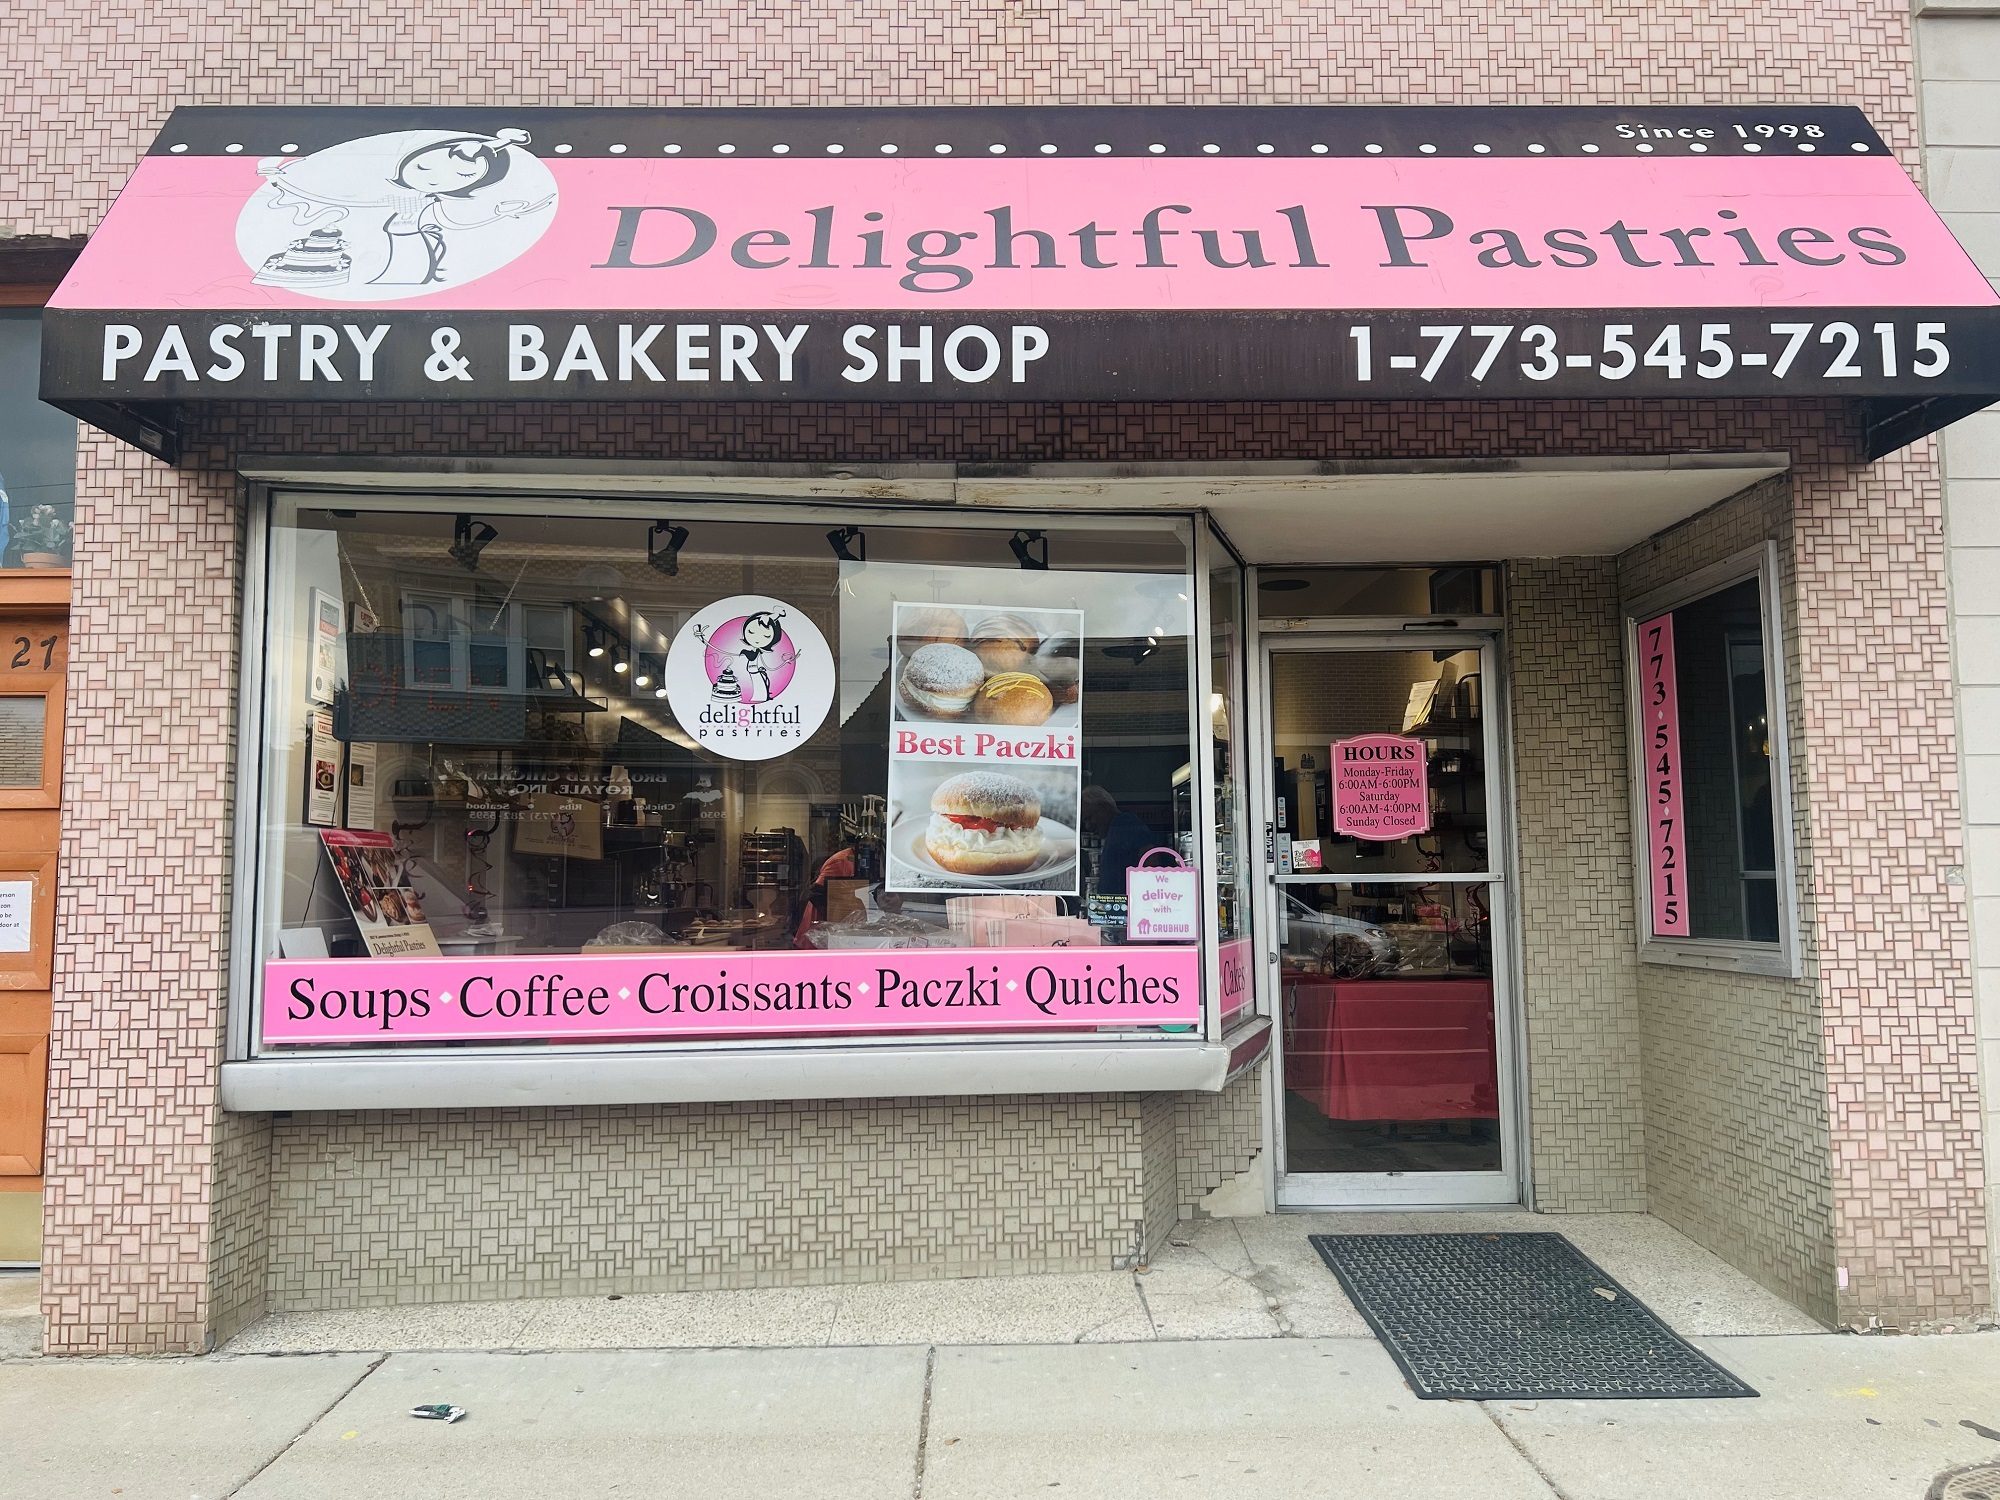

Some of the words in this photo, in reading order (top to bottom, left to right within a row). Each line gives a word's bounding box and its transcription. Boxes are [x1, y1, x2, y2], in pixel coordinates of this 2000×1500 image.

[1615, 124, 1715, 139] Since
[1732, 124, 1825, 138] 1998
[590, 204, 1331, 293] Delightful
[1360, 205, 1907, 269] Pastries
[102, 324, 392, 382] PASTRY
[423, 326, 474, 382] &
[508, 324, 810, 382] BAKERY
[841, 324, 1050, 383] SHOP
[1349, 322, 1950, 383] 1-773-545-7215
[700, 704, 800, 727] delightful
[700, 728, 801, 739] pastries
[896, 730, 966, 756] Best
[974, 733, 1076, 760] Paczki
[1344, 745, 1415, 760] HOURS
[1343, 766, 1414, 779] Monday-Friday
[1359, 791, 1400, 803] Saturday
[1346, 816, 1380, 828] Sunday
[1383, 815, 1416, 826] Closed
[1155, 875, 1169, 883] We
[1142, 889, 1183, 901] deliver
[1153, 905, 1172, 913] with
[1152, 923, 1190, 933] GRUBHUB
[1223, 957, 1246, 997] Cakes
[287, 977, 431, 1029] Soups
[459, 974, 610, 1018] Coffee
[638, 970, 852, 1014] Croissants
[874, 965, 1001, 1008] Paczki
[1025, 963, 1180, 1013] Quiches
